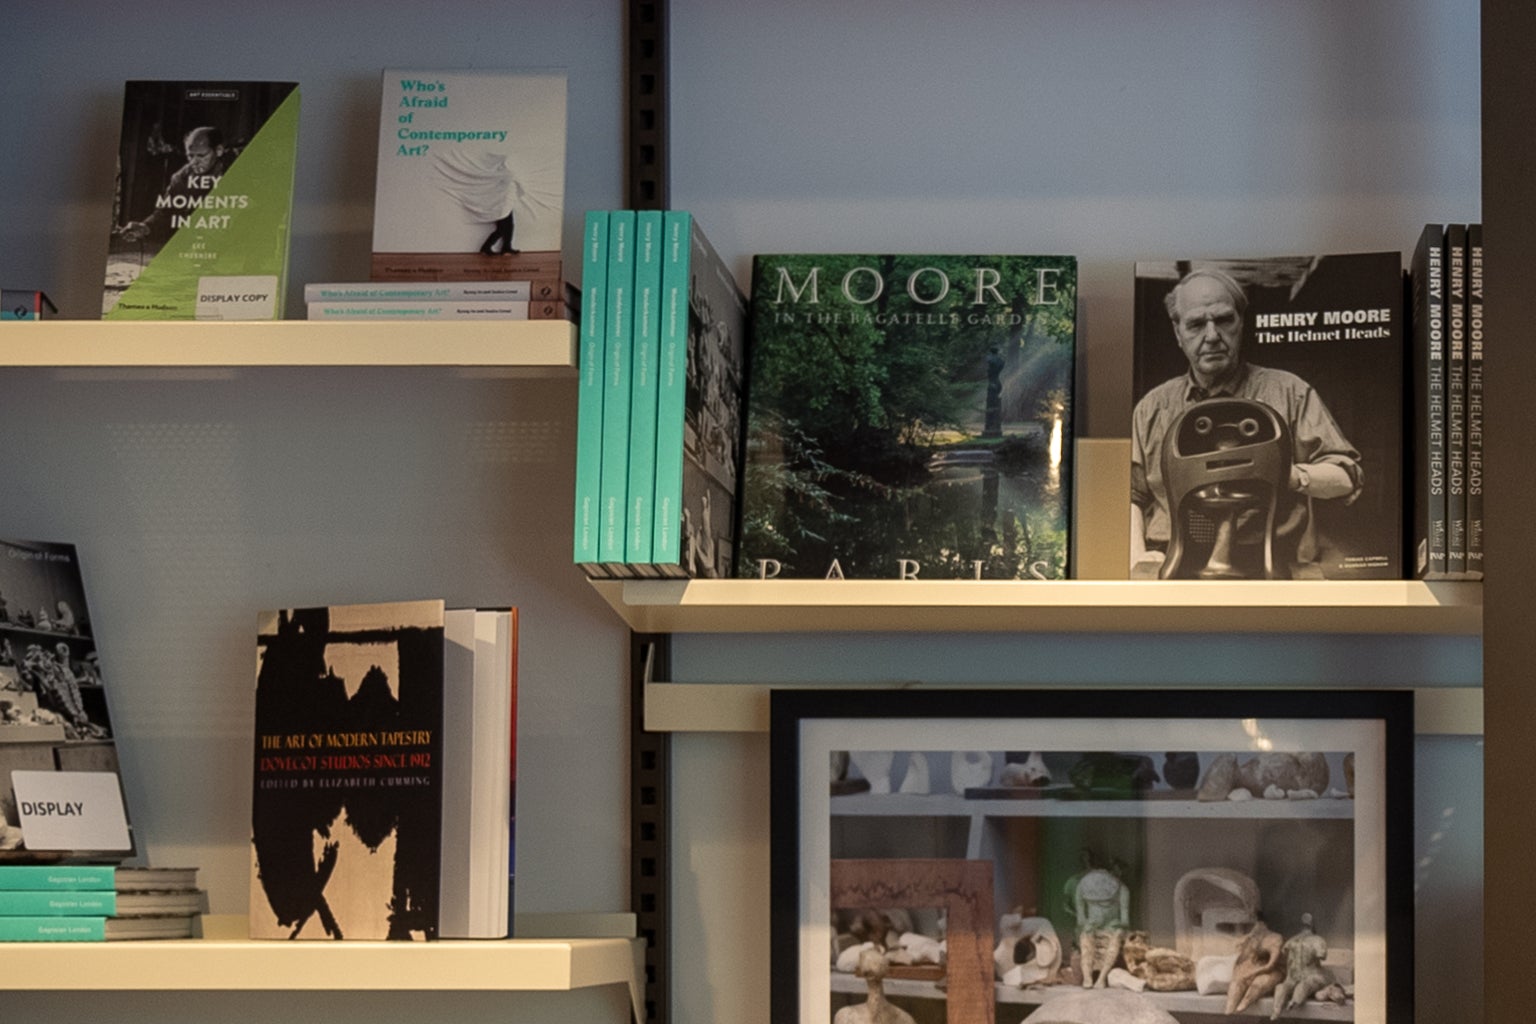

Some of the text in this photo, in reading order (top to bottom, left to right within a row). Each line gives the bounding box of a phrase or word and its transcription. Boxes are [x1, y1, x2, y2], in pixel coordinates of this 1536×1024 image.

[400, 80, 445, 92] Who's
[399, 96, 448, 108] Afraid
[398, 112, 413, 124] of
[397, 128, 507, 142] Contemporary
[397, 144, 429, 156] Art?
[187, 175, 222, 189] KEY
[155, 195, 249, 209] MOMENTS
[171, 215, 230, 229] IN ART
[773, 266, 1065, 305] MOORE
[200, 294, 268, 303] DISPLAY COPY
[774, 313, 795, 324] IN
[806, 313, 843, 324] THE
[851, 313, 960, 325] BAGATELLE
[1256, 309, 1390, 328] HENRY MOORE
[1255, 327, 1391, 344] The Helmet Heads
[1429, 246, 1443, 495] HENRY MOORE THE HELMET HEADS
[262, 730, 432, 749] THE ART OF MODERN TAPESTRY
[410, 753, 431, 767] 1912
[21, 802, 83, 816] DISPLAY
